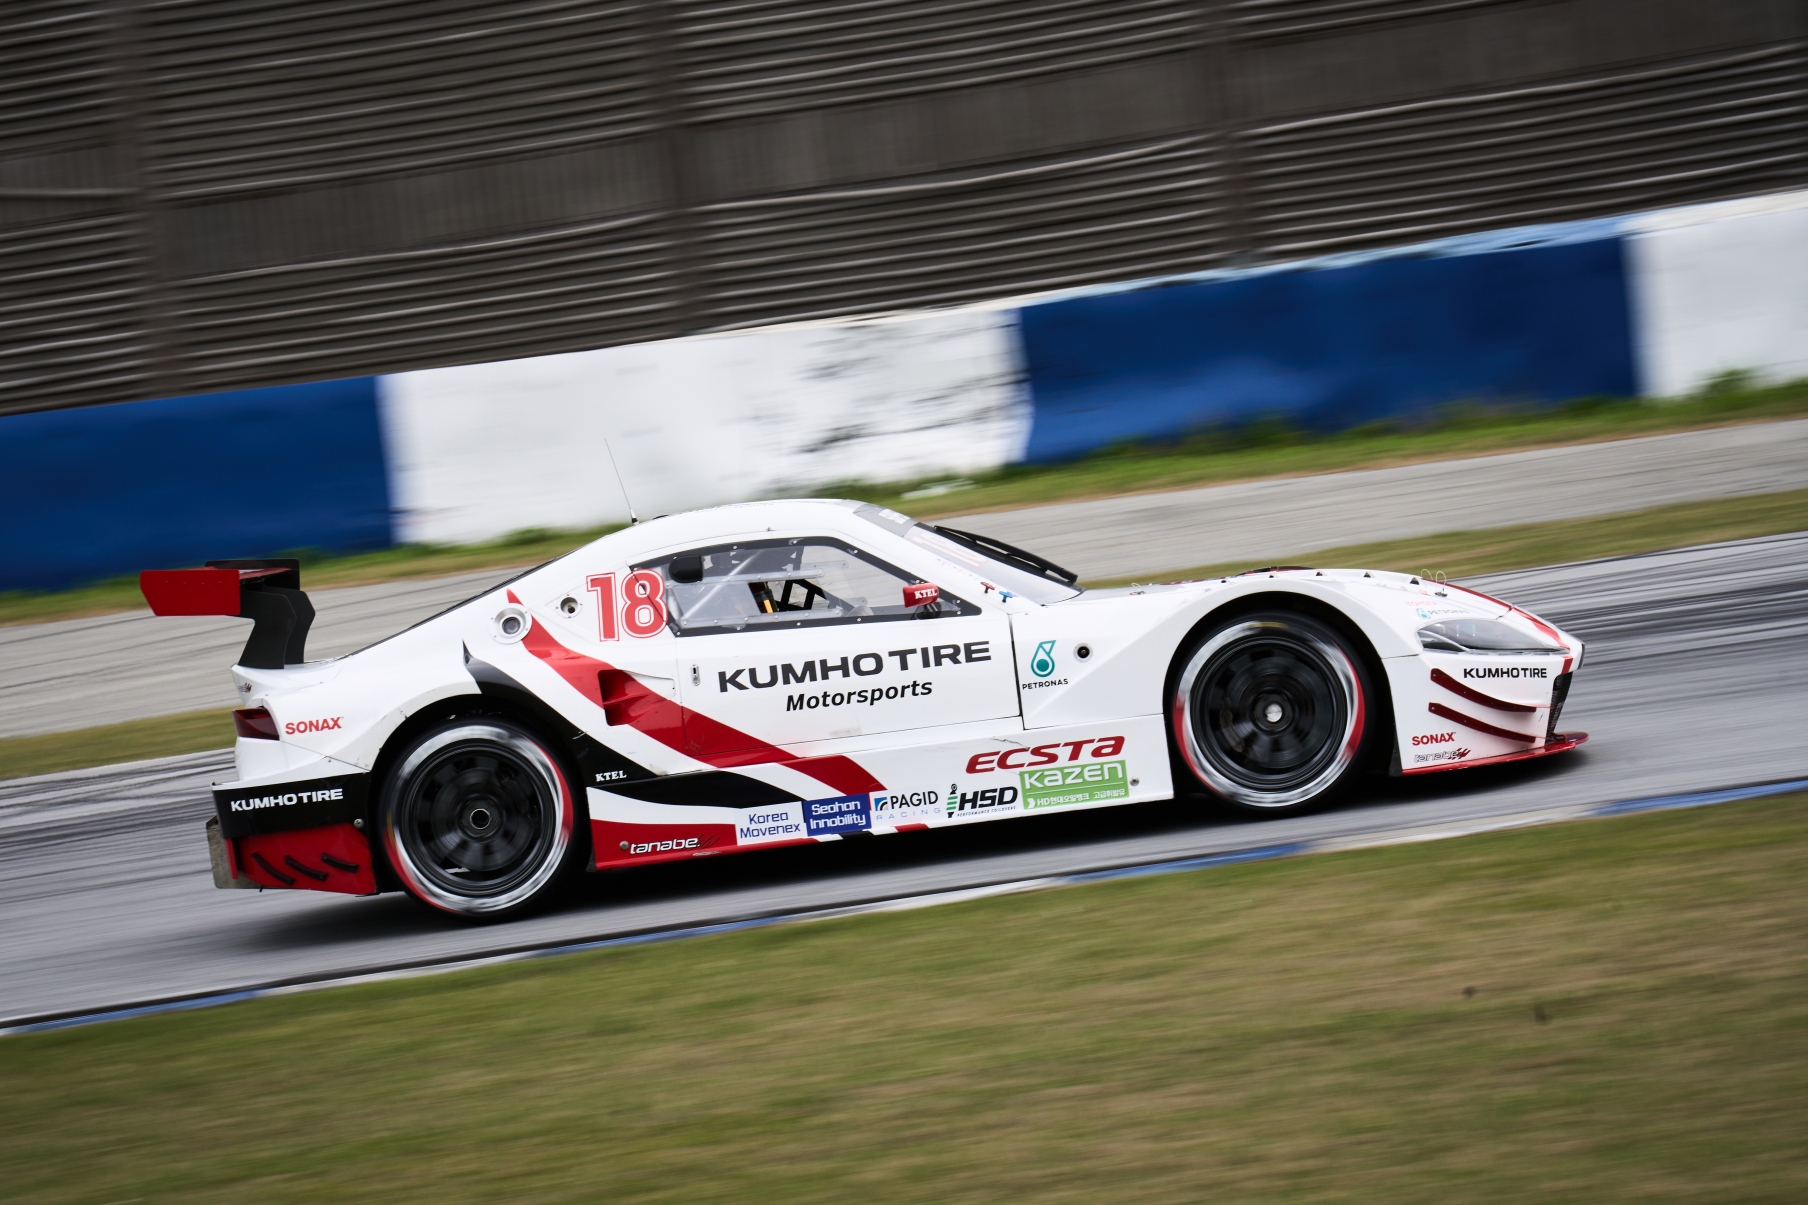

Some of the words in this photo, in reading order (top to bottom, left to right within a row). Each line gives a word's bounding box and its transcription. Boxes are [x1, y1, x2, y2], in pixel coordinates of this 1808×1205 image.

[914, 588, 938, 600] KTEL
[586, 567, 668, 642] 18
[718, 652, 883, 693] KUMHO
[888, 640, 992, 671] TIRE
[1022, 678, 1069, 690] PETRONAS
[786, 680, 933, 712] Motorsports
[285, 717, 342, 735] SONAX
[1412, 732, 1455, 746] SONAX
[595, 770, 627, 782] KTEL
[231, 793, 298, 811] KUMHO
[298, 788, 344, 803] TIRE
[890, 790, 939, 809] PAGID
[958, 786, 1018, 811] HSD
[811, 800, 861, 816] Seohan
[876, 807, 941, 821] RACING
[748, 812, 789, 825] Korea
[810, 813, 867, 830] Innobility
[740, 822, 801, 839] Movenex
